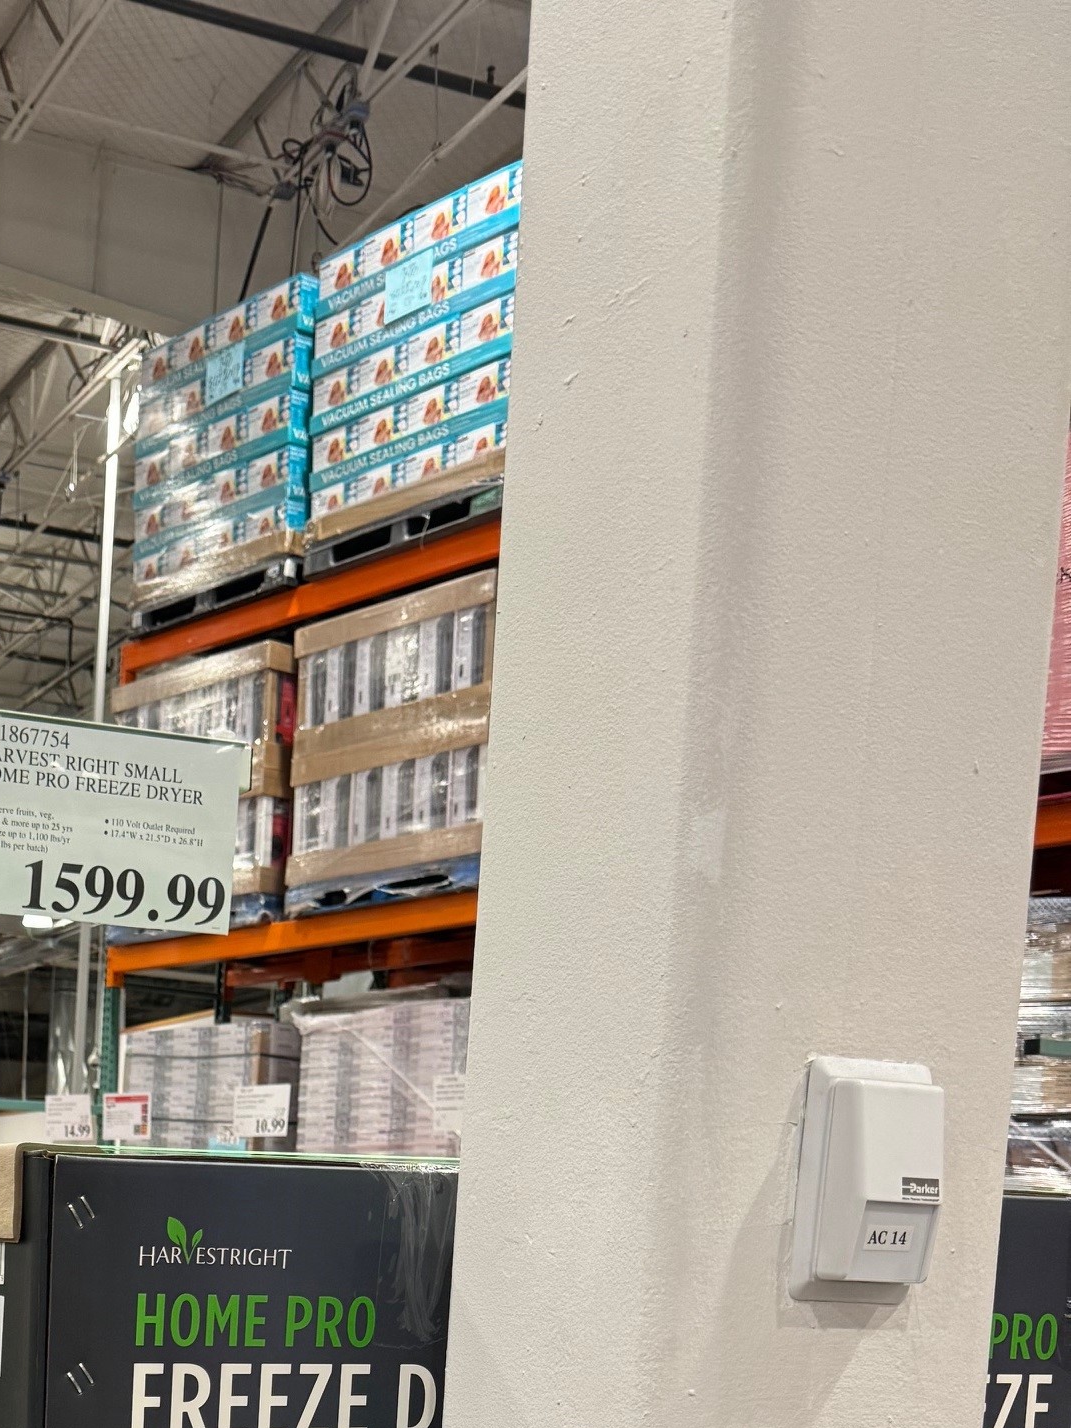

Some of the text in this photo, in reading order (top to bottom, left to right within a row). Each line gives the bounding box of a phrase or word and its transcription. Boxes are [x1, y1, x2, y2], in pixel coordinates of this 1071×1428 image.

[320, 341, 368, 368] VACUUM
[418, 301, 450, 326] BAGS
[320, 362, 450, 427] VACUUM SEALING BAGS
[319, 424, 450, 484] VACUUM SEALING BAGS
[0, 724, 70, 749] 1867754
[65, 755, 120, 777] RIGHT
[124, 762, 183, 784] SMALL
[36, 771, 70, 790] PRO
[75, 775, 141, 799] FREEZE
[146, 784, 203, 806] DRYER
[2, 817, 9, 826] &
[11, 819, 29, 828] more
[31, 822, 40, 831] up
[42, 823, 49, 831] to
[51, 822, 60, 831] 25
[61, 825, 73, 834] yrs
[16, 807, 37, 818] fruits,
[39, 811, 54, 821] veg.
[111, 818, 195, 835] 110 Volt Outlet Required
[1, 840, 11, 849] lbs
[13, 843, 24, 851] per
[26, 842, 48, 853] batch)
[8, 830, 17, 839] up
[19, 831, 26, 839] to
[50, 833, 71, 845] lbs/yr
[21, 860, 225, 926] 1599.99
[909, 1182, 939, 1195] Parker
[139, 1231, 292, 1270] HARVESTRIGHT
[867, 1230, 907, 1246] AC 14
[134, 1293, 376, 1348] HOME PRO
